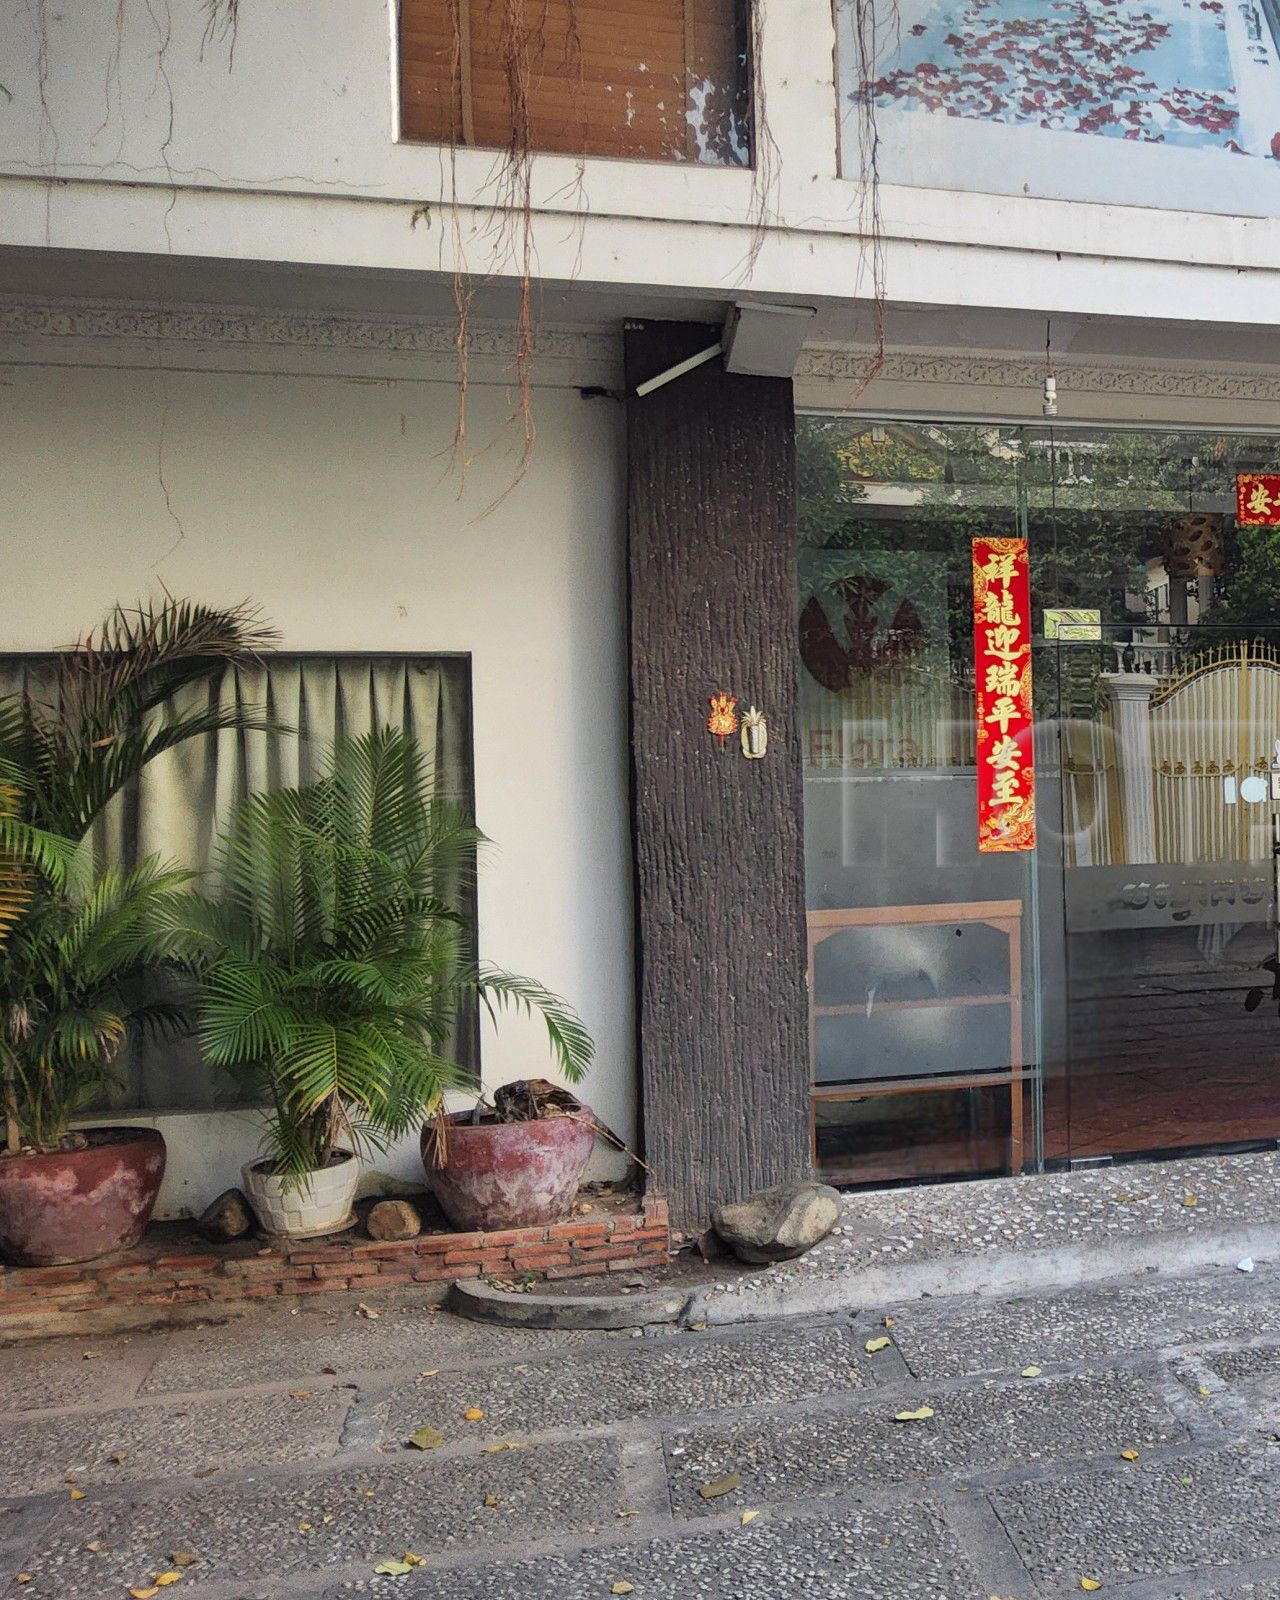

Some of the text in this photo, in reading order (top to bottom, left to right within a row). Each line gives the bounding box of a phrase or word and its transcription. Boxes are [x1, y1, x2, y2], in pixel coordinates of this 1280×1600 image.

[981, 553, 1023, 807] 祥龍迎瑞平安至
